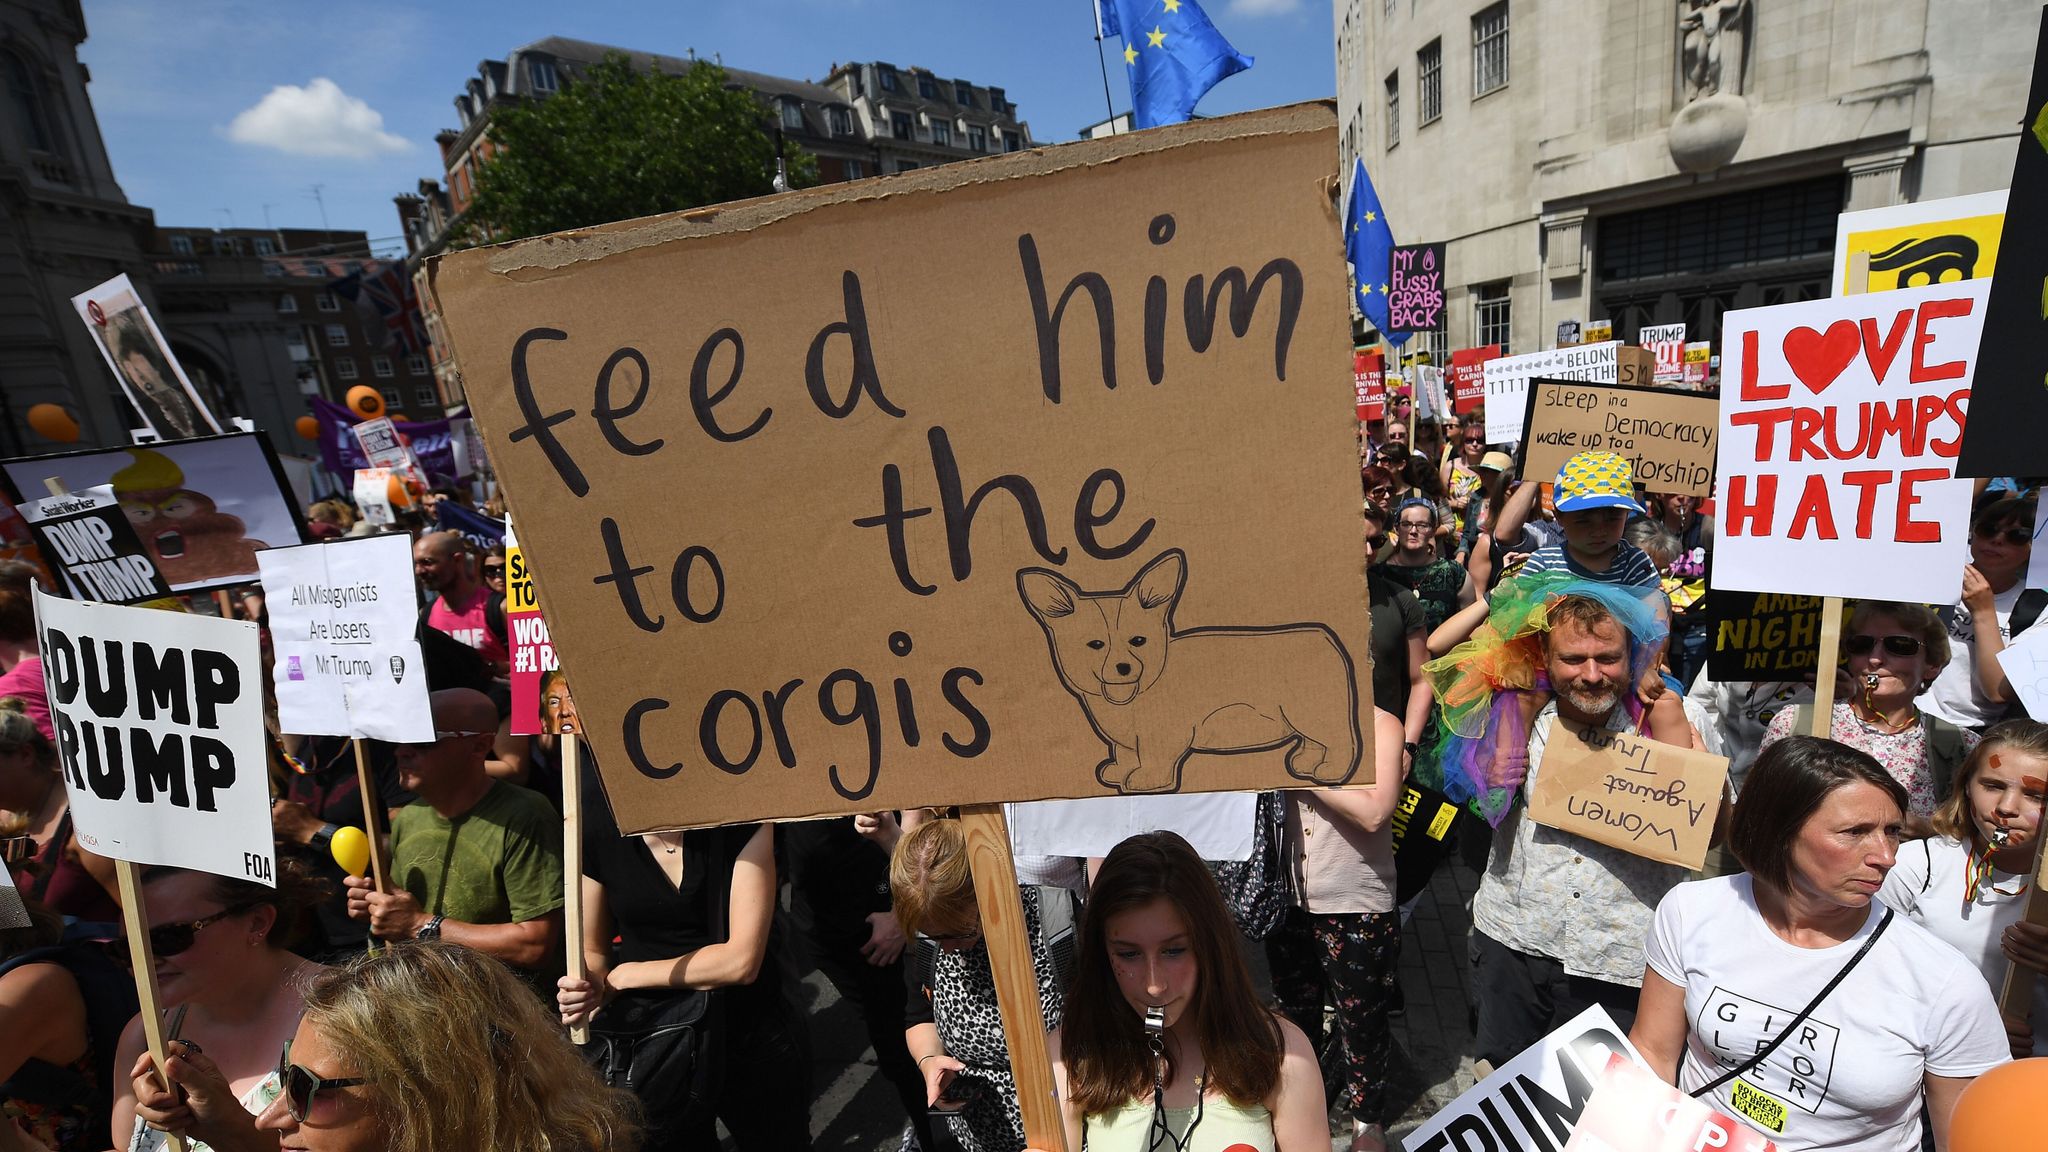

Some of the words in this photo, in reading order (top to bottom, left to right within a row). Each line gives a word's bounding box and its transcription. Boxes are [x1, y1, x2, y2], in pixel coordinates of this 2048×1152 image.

[1393, 249, 1417, 270] MY
[1388, 289, 1443, 309] GRABS
[1391, 307, 1438, 328] BACK
[1642, 327, 1684, 343] TRUMP
[508, 269, 907, 499] feed
[1018, 213, 1304, 405] him
[1456, 366, 1472, 374] THIS
[1355, 379, 1381, 388] RNIVAL
[1457, 386, 1485, 396] RESISTA
[1536, 428, 1578, 447] wake
[1581, 433, 1602, 450] up
[1608, 437, 1622, 449] to
[1730, 388, 1973, 462] TRUMPS
[1626, 452, 1709, 491] atorship
[64, 498, 96, 512] Worker
[1725, 467, 1951, 543] HATE
[40, 516, 116, 566] DUMP
[592, 516, 725, 634] to
[852, 425, 1157, 597] the
[68, 554, 159, 604] TRUMP
[512, 580, 536, 607] TO
[292, 584, 305, 606] All
[308, 582, 378, 608] Misogynists
[310, 620, 328, 639] Are
[329, 620, 371, 640] Losers
[315, 655, 330, 674] Mr
[331, 655, 372, 680] Trump
[515, 645, 538, 673] #1
[621, 630, 991, 802] corgis
[52, 703, 236, 812] RUMP
[1577, 724, 1657, 774] Trump
[1603, 775, 1706, 827] Against
[1567, 795, 1678, 851] Women
[243, 852, 273, 882] FOA
[1735, 1094, 1780, 1124] BOLLOCKS
[1737, 1083, 1783, 1112] BOLLOCKS
[1738, 1089, 1748, 1099] TO
[1749, 1096, 1782, 1118] BREXIT
[1747, 1107, 1779, 1130] TRUMP
